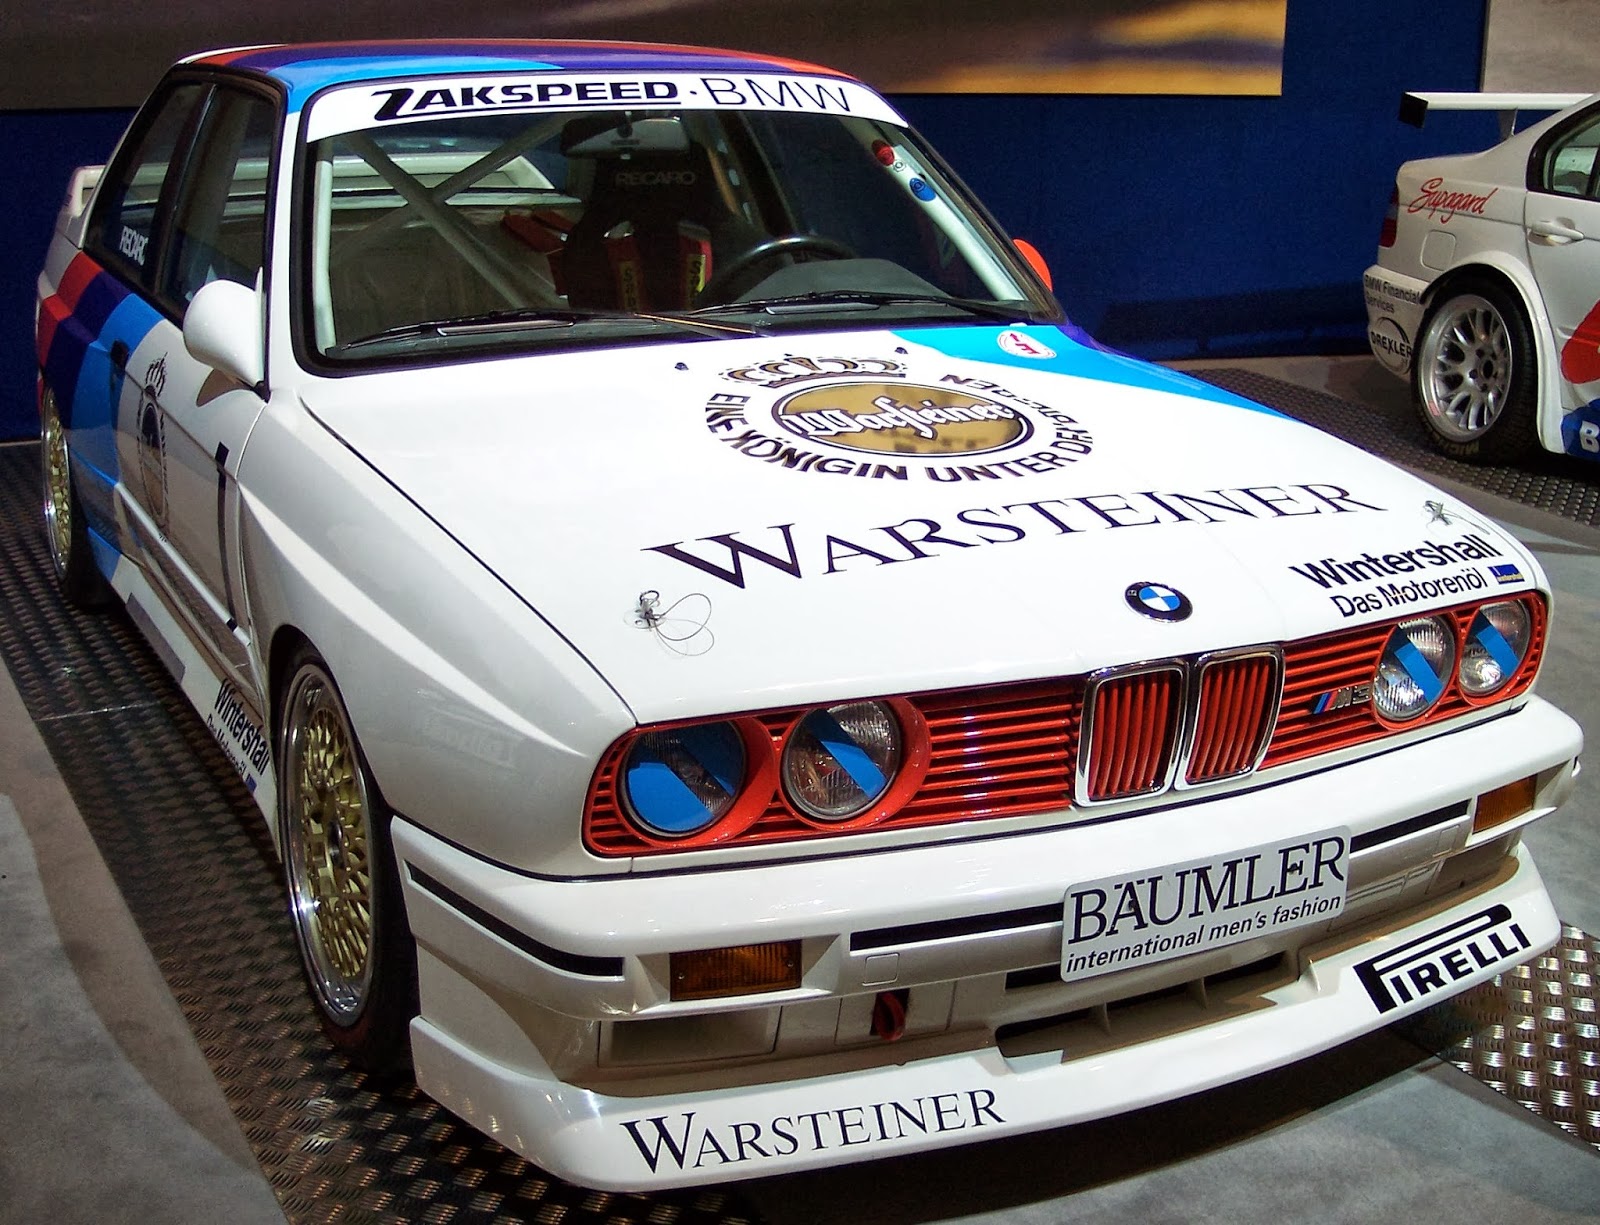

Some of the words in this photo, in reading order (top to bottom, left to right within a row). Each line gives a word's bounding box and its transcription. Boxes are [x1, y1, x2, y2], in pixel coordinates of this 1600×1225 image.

[372, 81, 681, 122] ZAKSPEED
[701, 77, 851, 112] BMW
[615, 170, 697, 186] RECARO
[1383, 281, 1420, 304] Financial
[719, 429, 909, 480] KÖNIGIN
[924, 451, 1078, 482] UNTER
[640, 483, 1388, 589] WARSTEINER
[1288, 534, 1504, 589] Wintershall
[1330, 593, 1383, 618] Das
[1376, 567, 1489, 606] Motorenöl
[214, 678, 270, 776] Wintershall
[1067, 836, 1345, 945] BÄUMLER
[1066, 925, 1205, 973] international
[1209, 911, 1267, 941] men's
[1271, 895, 1342, 926] fashion
[1353, 903, 1532, 1015] PIRELLI
[619, 1088, 1007, 1174] WARSTEINER
